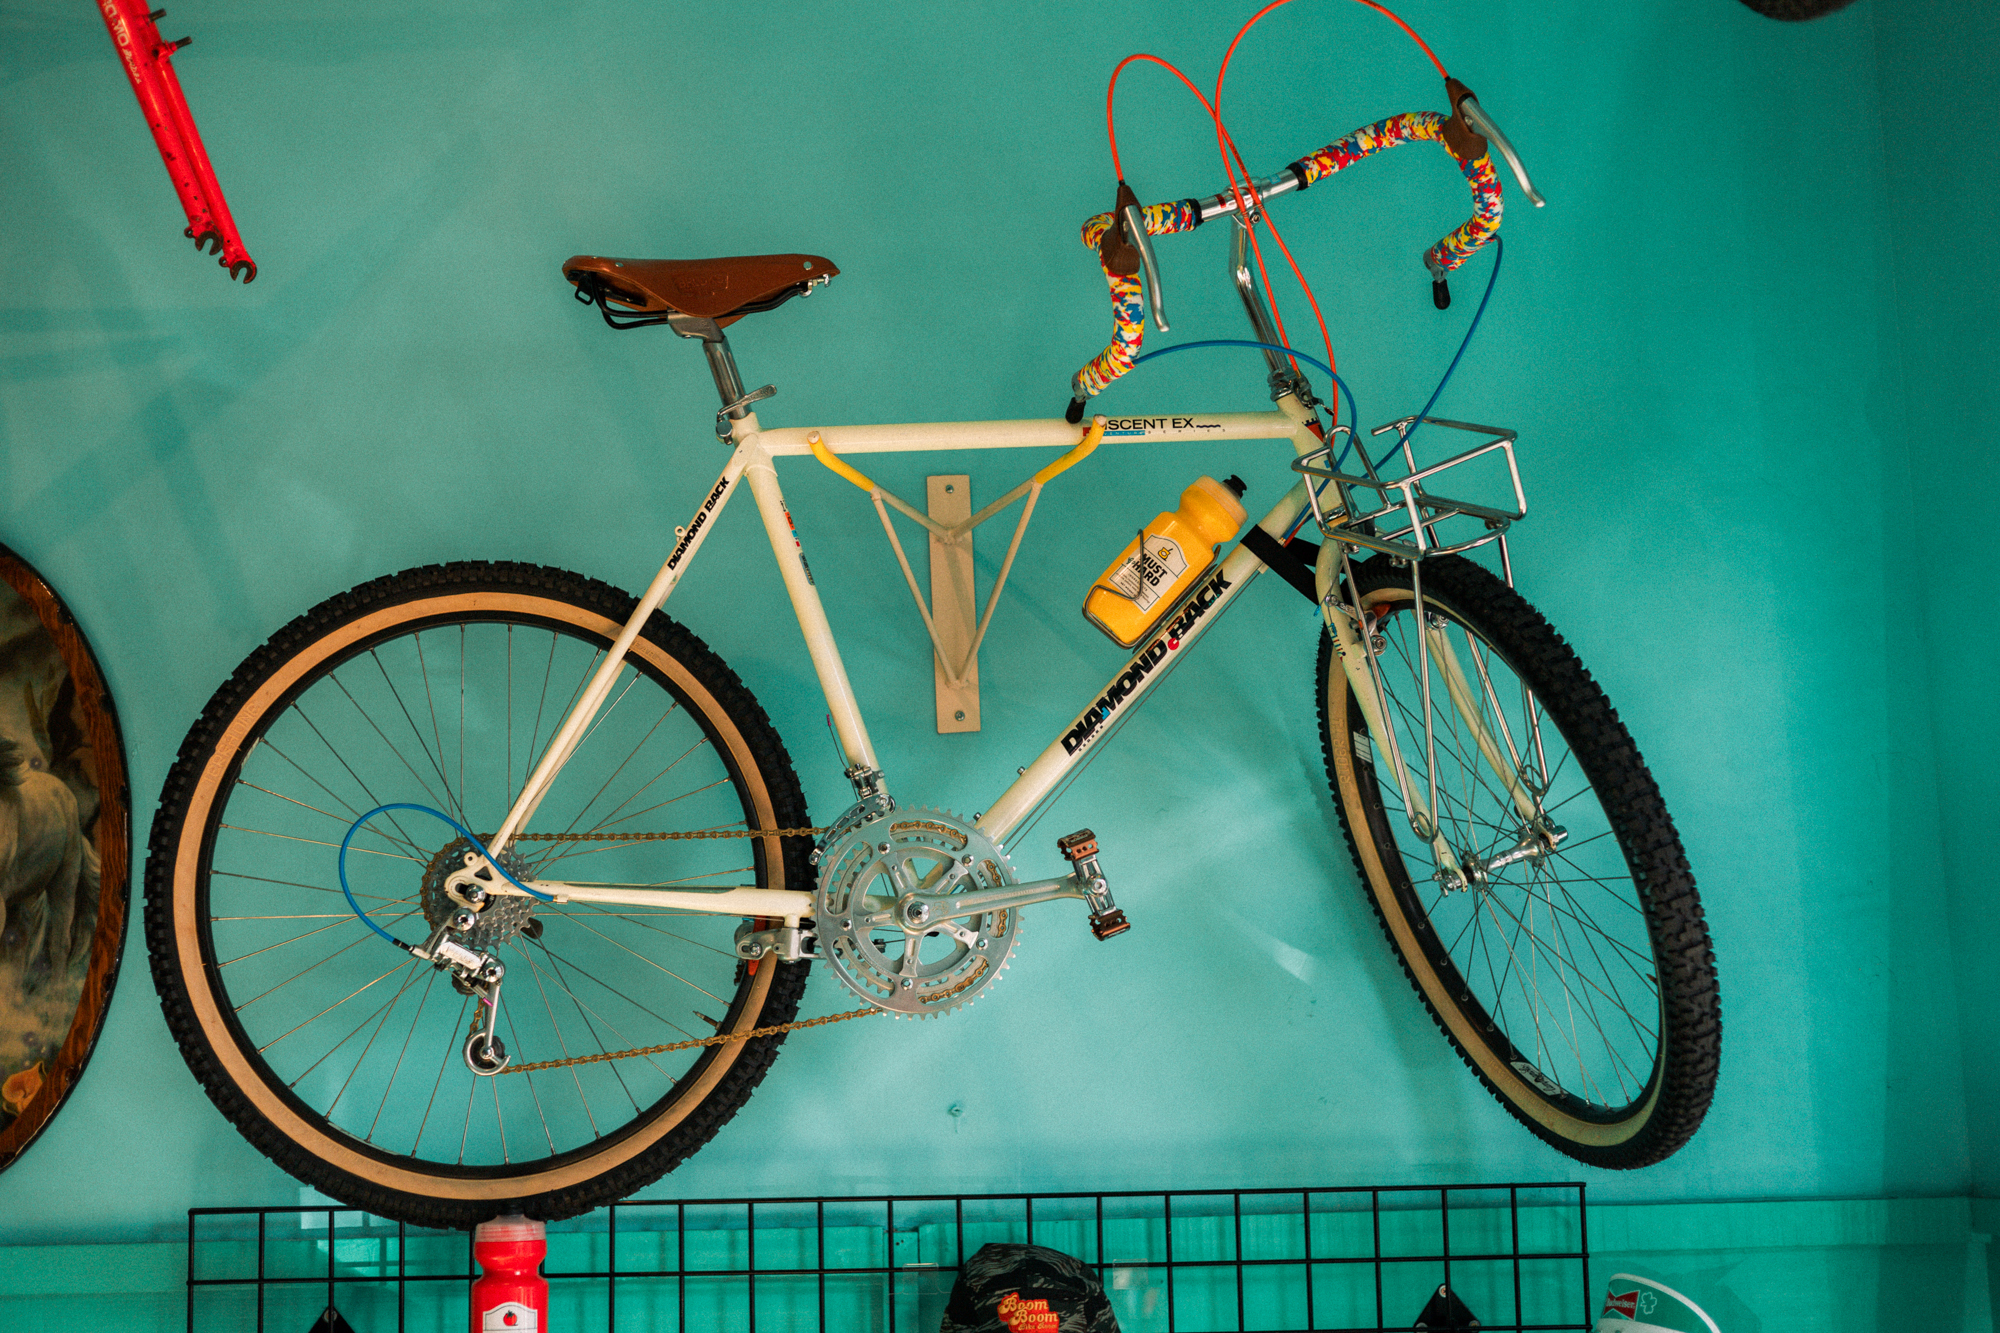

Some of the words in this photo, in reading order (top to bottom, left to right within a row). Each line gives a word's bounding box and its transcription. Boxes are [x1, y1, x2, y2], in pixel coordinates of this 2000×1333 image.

[1104, 418, 1168, 431] SCENT
[1172, 417, 1195, 429] EX
[667, 511, 707, 571] DIAMOND
[704, 476, 730, 513] BACK
[1132, 560, 1160, 587] HARD
[1139, 553, 1168, 579] MUST
[1060, 638, 1168, 757] DIAMOND
[1165, 568, 1232, 641] BACK
[999, 1294, 1049, 1315] Boom
[1009, 1306, 1059, 1326] Boom
